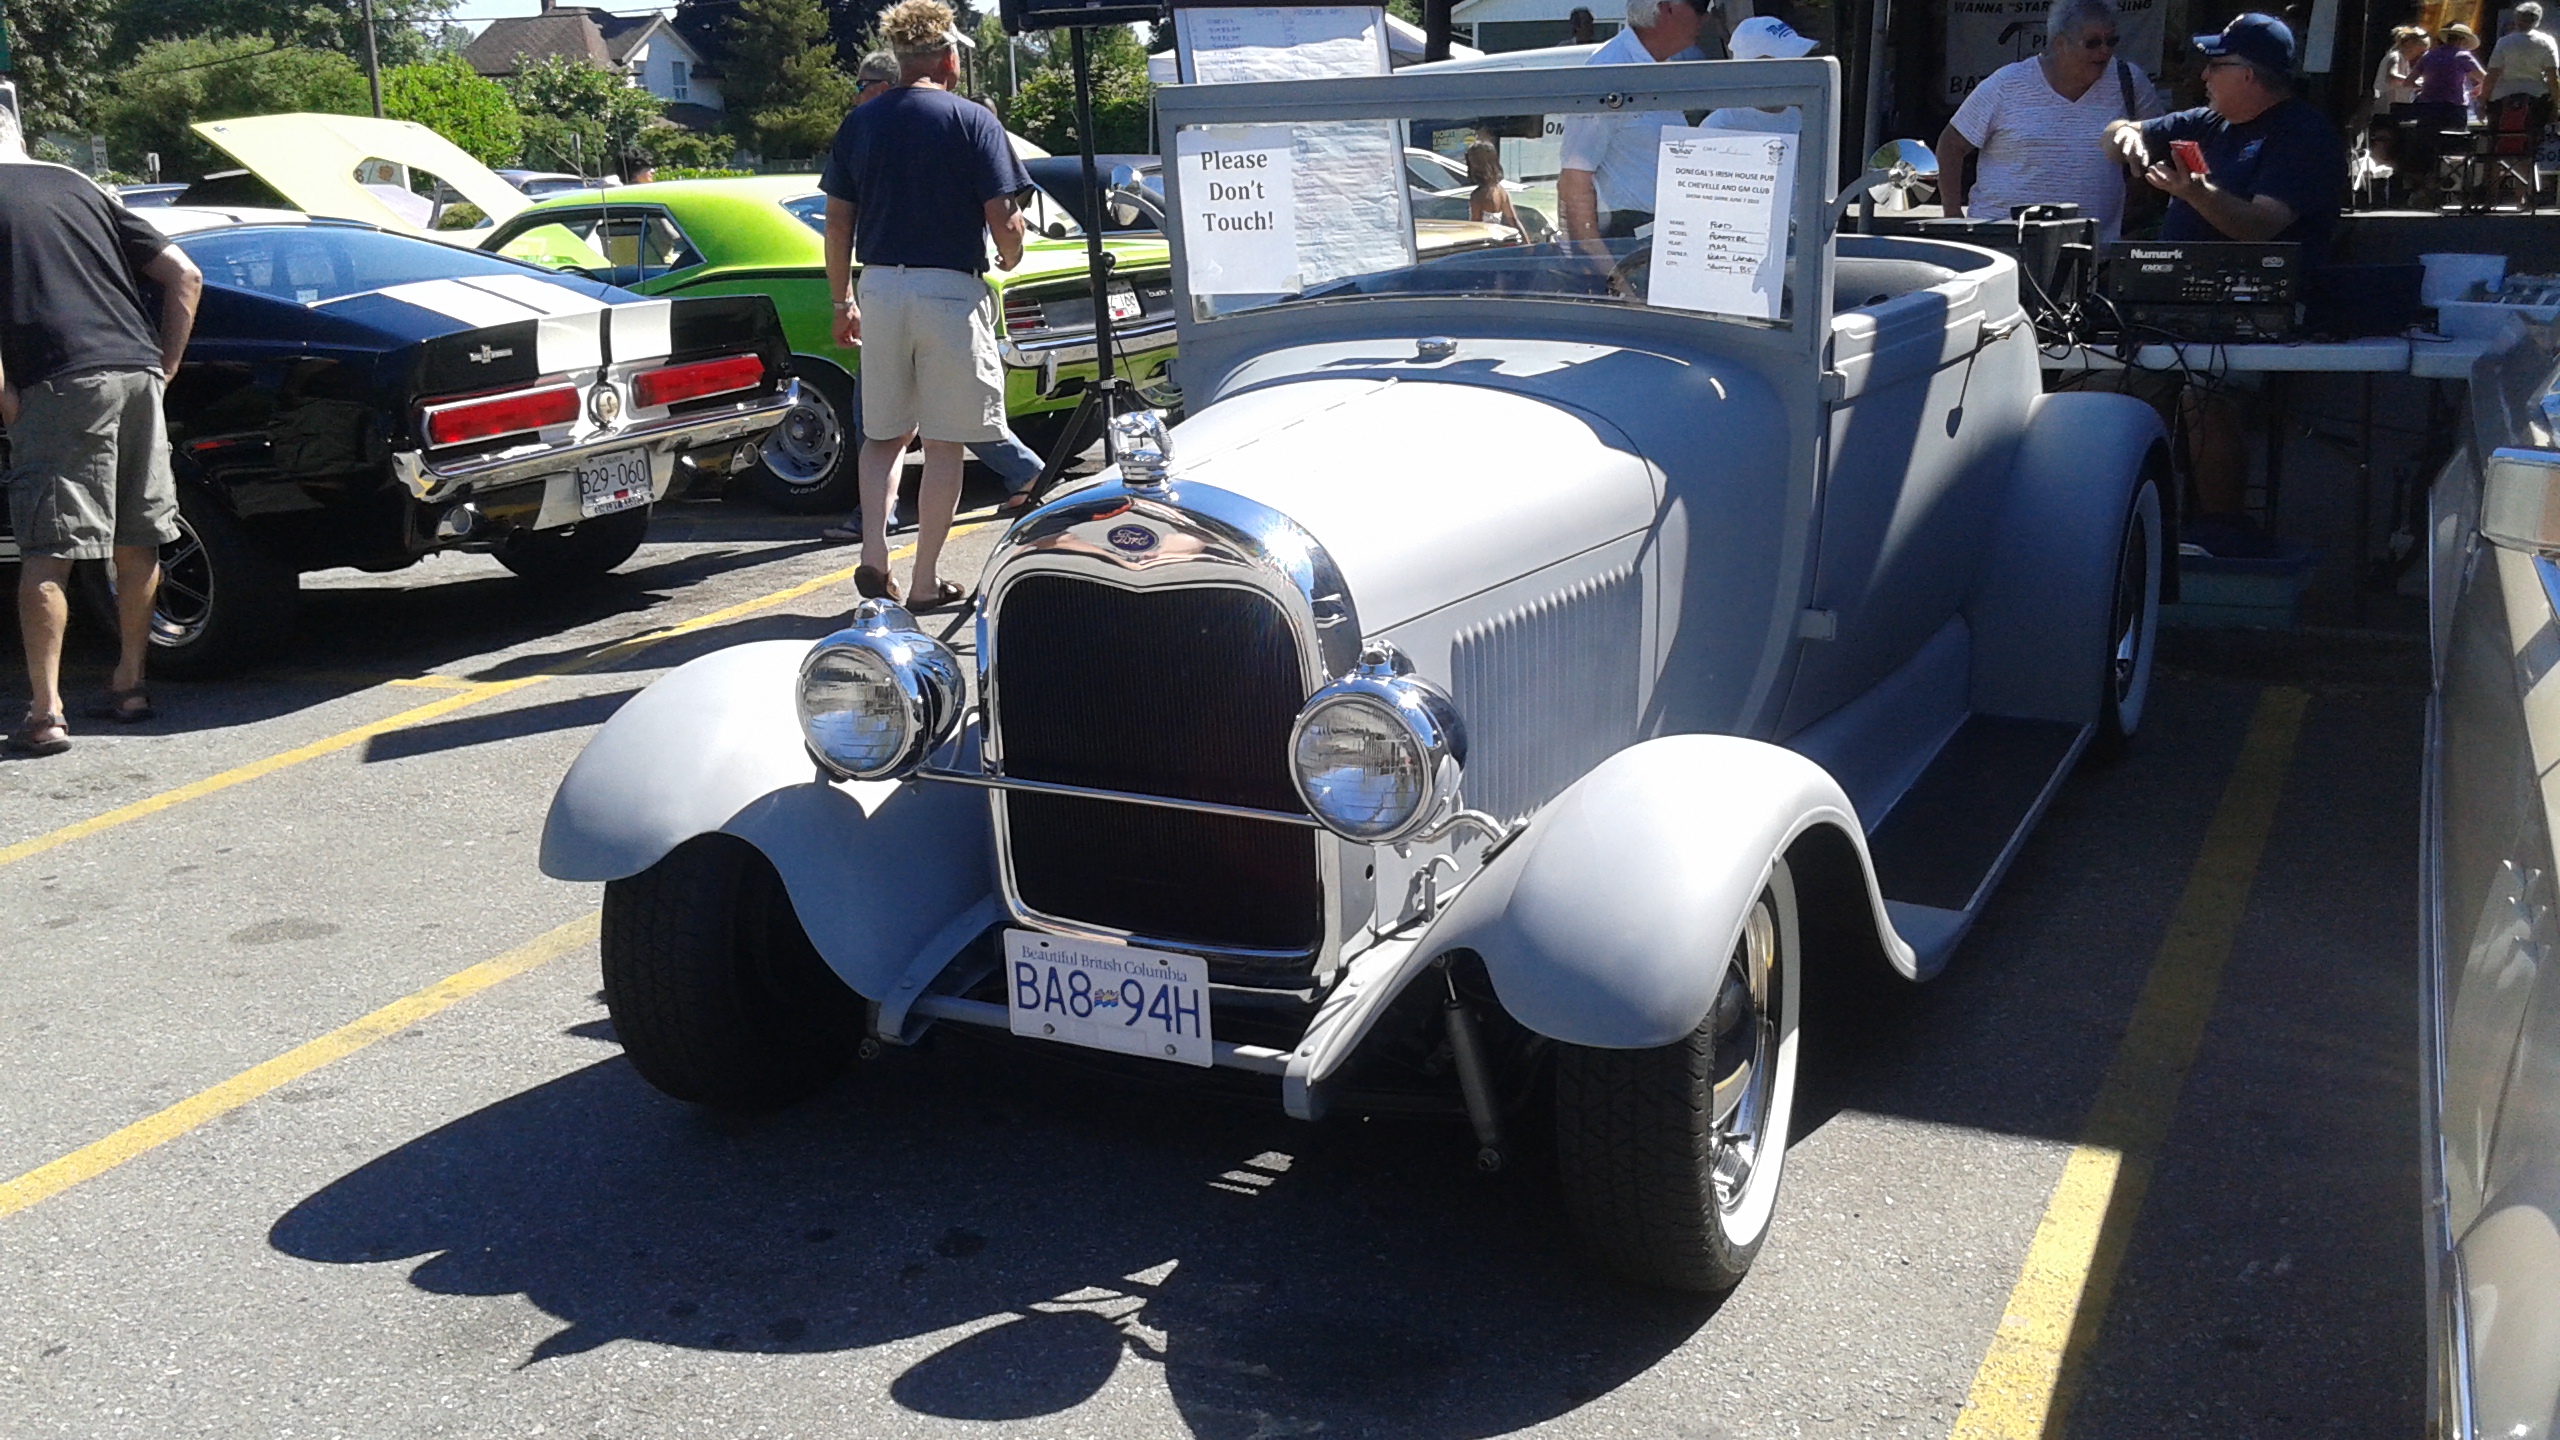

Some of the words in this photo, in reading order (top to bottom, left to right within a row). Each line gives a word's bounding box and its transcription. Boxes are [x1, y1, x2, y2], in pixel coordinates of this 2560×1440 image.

[1954, 1, 2003, 14] WANNA
[1200, 150, 1268, 171] Please
[1675, 167, 1714, 177] DONEGAL'S
[1715, 170, 1733, 179] IRISH
[1734, 172, 1758, 180] HOUSE
[1760, 174, 1774, 182] PUB
[1209, 179, 1265, 201] Don't
[1687, 181, 1720, 190] CHEVELLE
[1721, 183, 1737, 192] AND
[1738, 185, 1750, 193] GM
[1752, 186, 1770, 195] CLUB
[1202, 210, 1273, 232] Touch!
[2130, 249, 2183, 259] Numark
[580, 459, 646, 495] B29-060
[1112, 529, 1149, 546] Ford
[1022, 945, 1077, 966] Beautiful
[1081, 954, 1122, 973] British
[1124, 961, 1188, 982] Columbia
[1015, 961, 1093, 1018] BA8
[1120, 978, 1201, 1039] 94H
